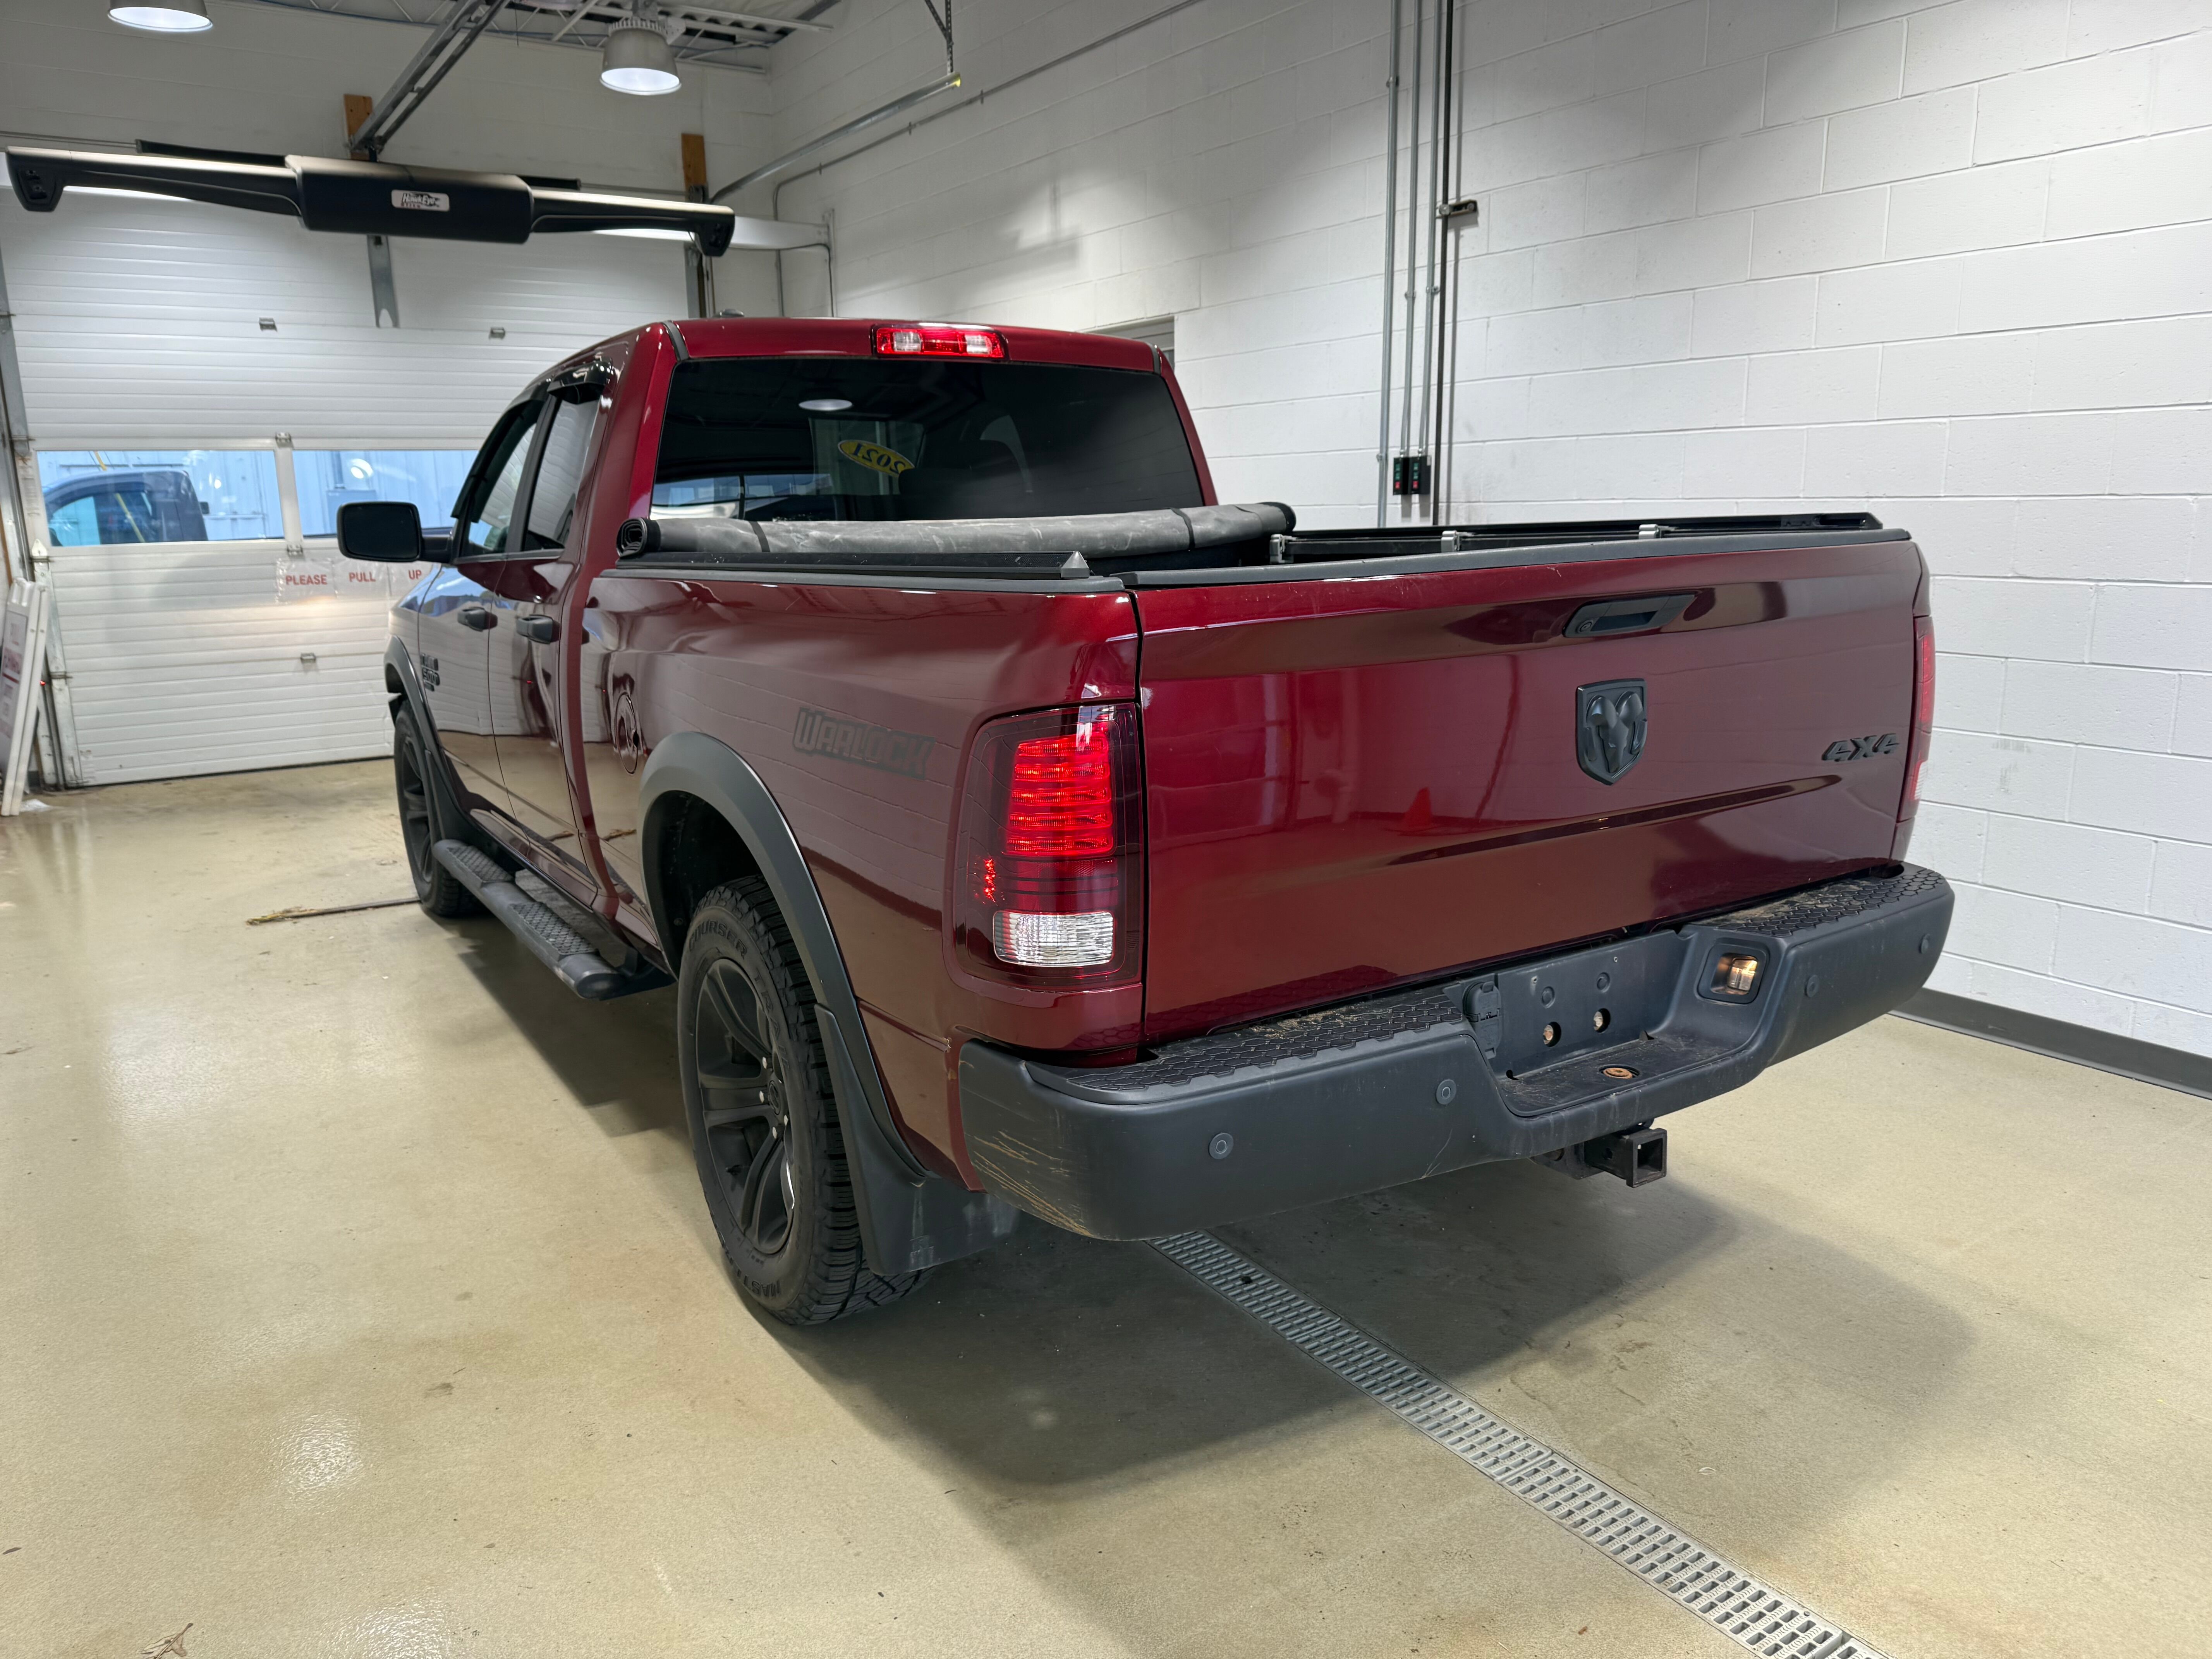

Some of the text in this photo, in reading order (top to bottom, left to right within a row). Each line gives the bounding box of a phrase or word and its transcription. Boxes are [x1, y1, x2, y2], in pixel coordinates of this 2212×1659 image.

[285, 570, 422, 586] PLEASE PULL UP
[793, 707, 936, 781] WARLOCK
[689, 919, 747, 960] COURSER
